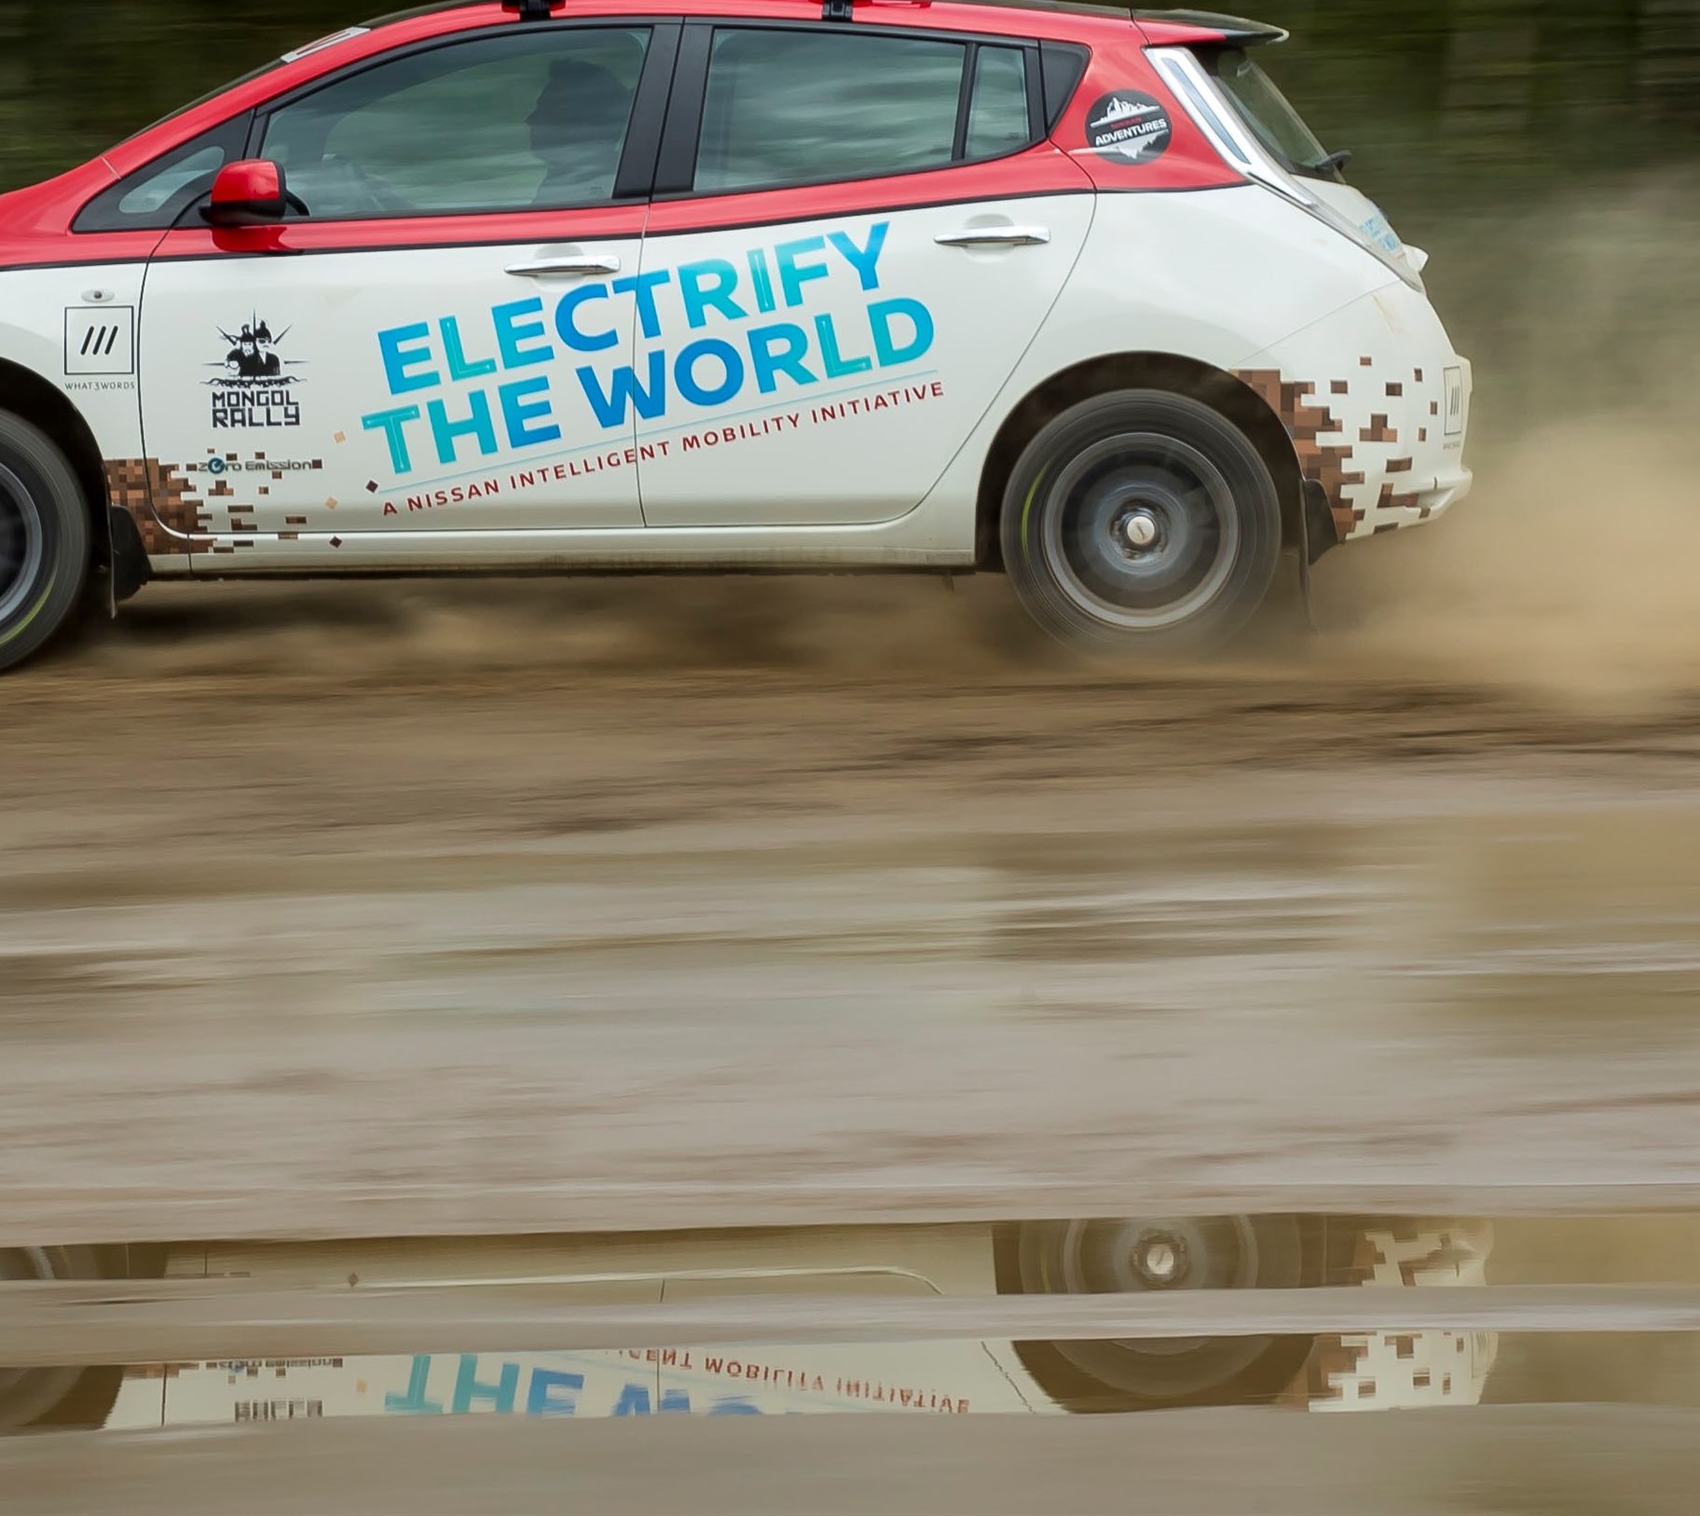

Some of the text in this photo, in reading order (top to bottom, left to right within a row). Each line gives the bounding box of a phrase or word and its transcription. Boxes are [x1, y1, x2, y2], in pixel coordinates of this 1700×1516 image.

[1095, 118, 1168, 146] ADVENTURES
[377, 221, 890, 395] ELECTRIFY
[64, 381, 135, 391] WHAT3WORDS
[212, 390, 299, 407] MONGOL
[361, 297, 935, 475] THE WORLD
[212, 406, 300, 428] RALLY
[382, 381, 945, 516] A NISSAN INTELLIGENT MOBILITY INITIATIVE
